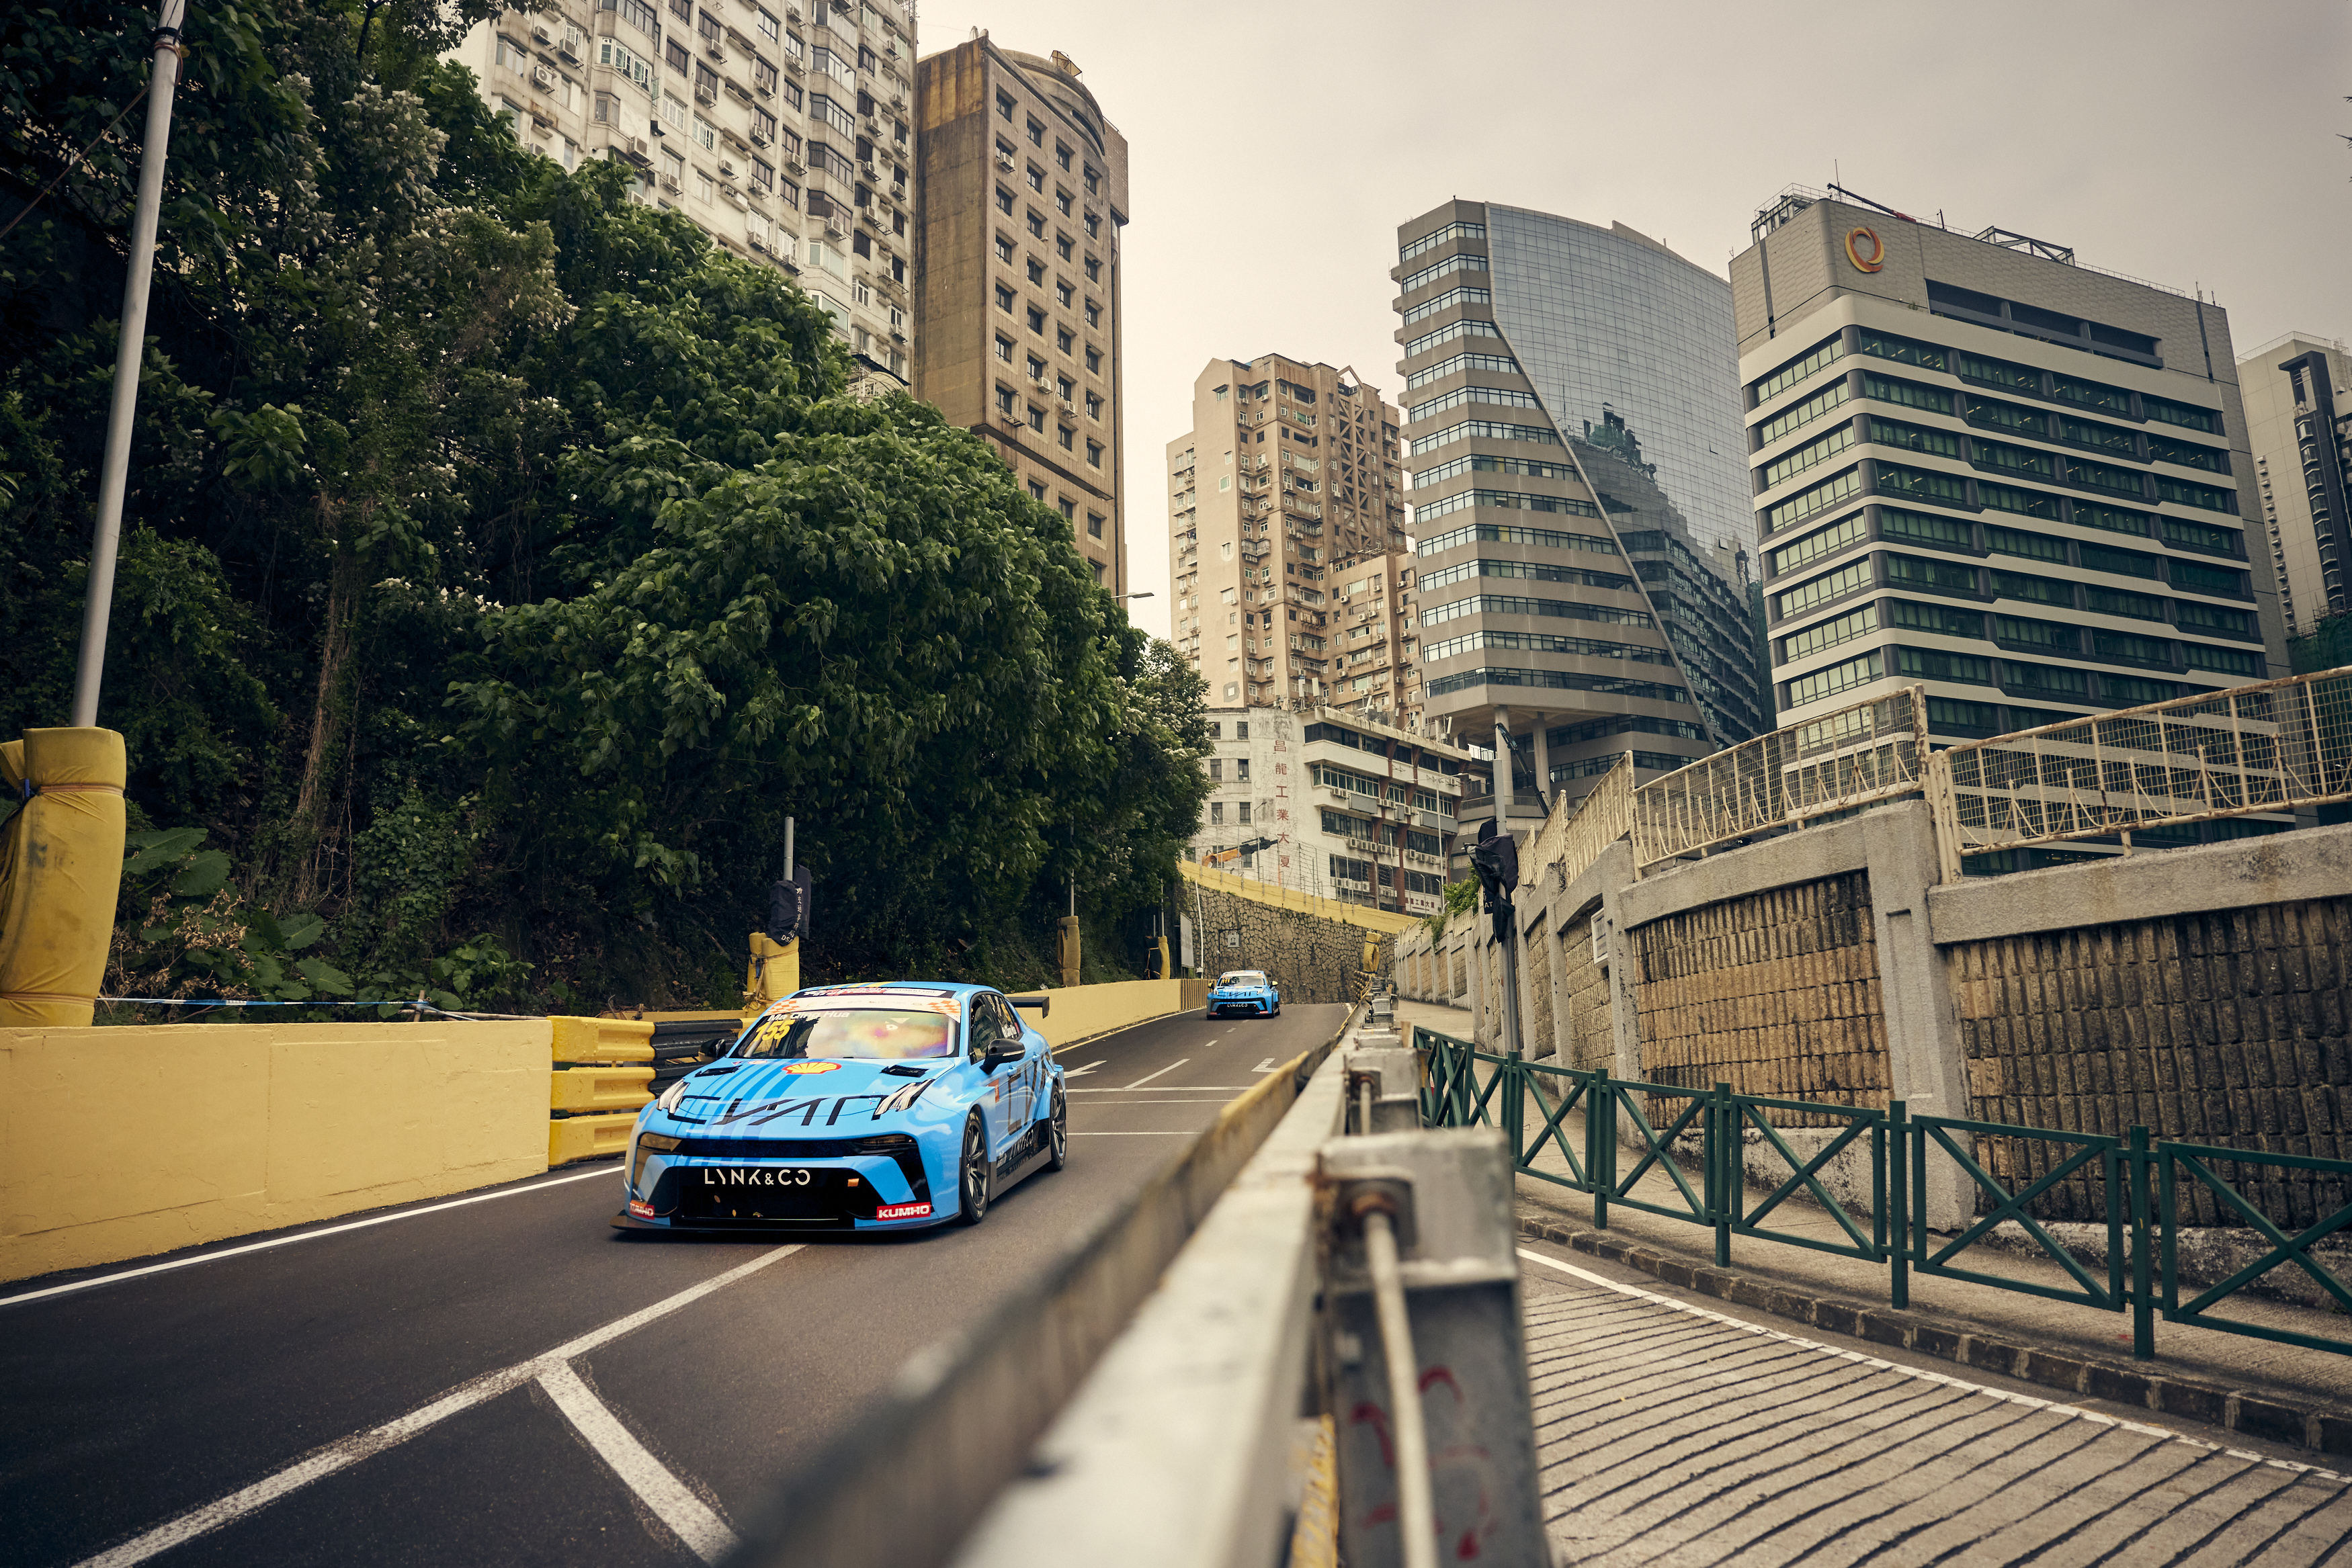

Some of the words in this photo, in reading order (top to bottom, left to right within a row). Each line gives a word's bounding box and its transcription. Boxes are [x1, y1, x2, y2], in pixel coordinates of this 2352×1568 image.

[767, 1014, 788, 1022] Ma
[753, 1019, 796, 1042] 155
[629, 1203, 654, 1217] KUMHO
[878, 1205, 930, 1219] KUMHO
